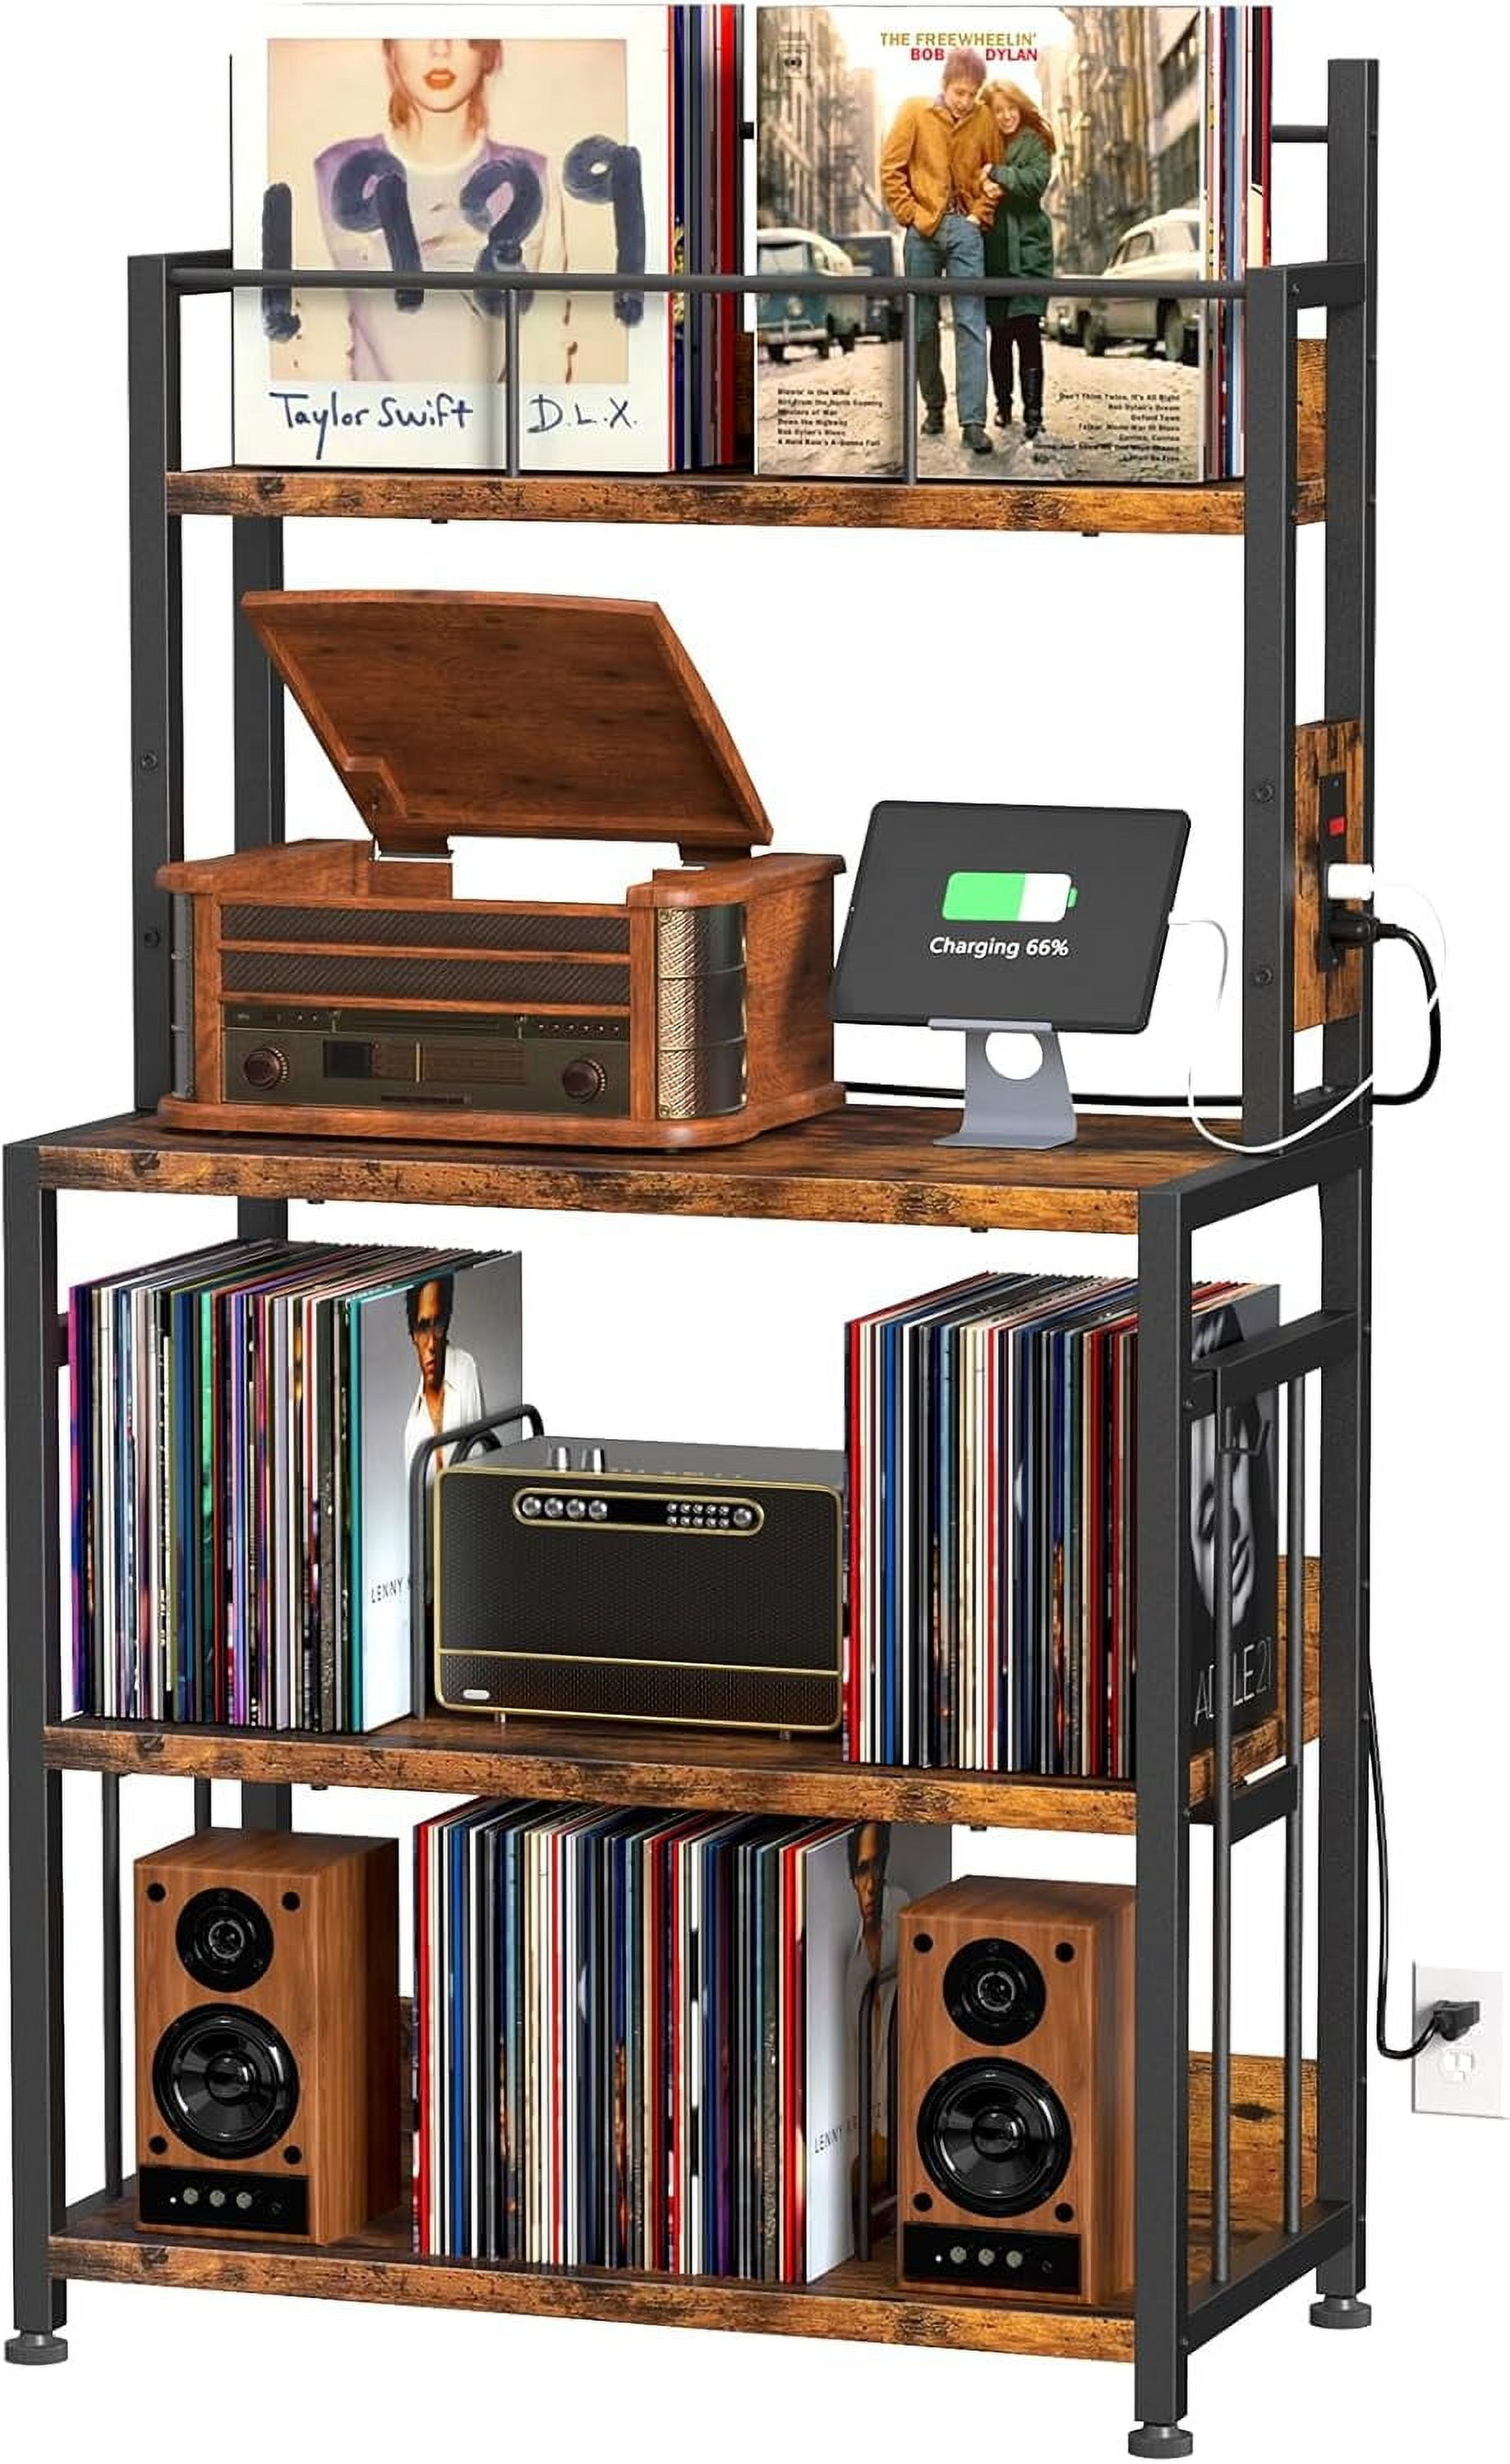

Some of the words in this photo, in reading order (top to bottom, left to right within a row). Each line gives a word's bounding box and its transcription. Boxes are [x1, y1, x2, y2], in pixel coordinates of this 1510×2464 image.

[881, 33, 910, 47] THE
[915, 33, 1037, 47] FREEWHEELIN'
[911, 48, 945, 61] BOB
[986, 48, 1038, 61] DYLAN
[269, 391, 370, 460] Taylor
[378, 393, 474, 429] Swift
[929, 936, 1020, 959] Charging
[1026, 938, 1069, 956] 66%
